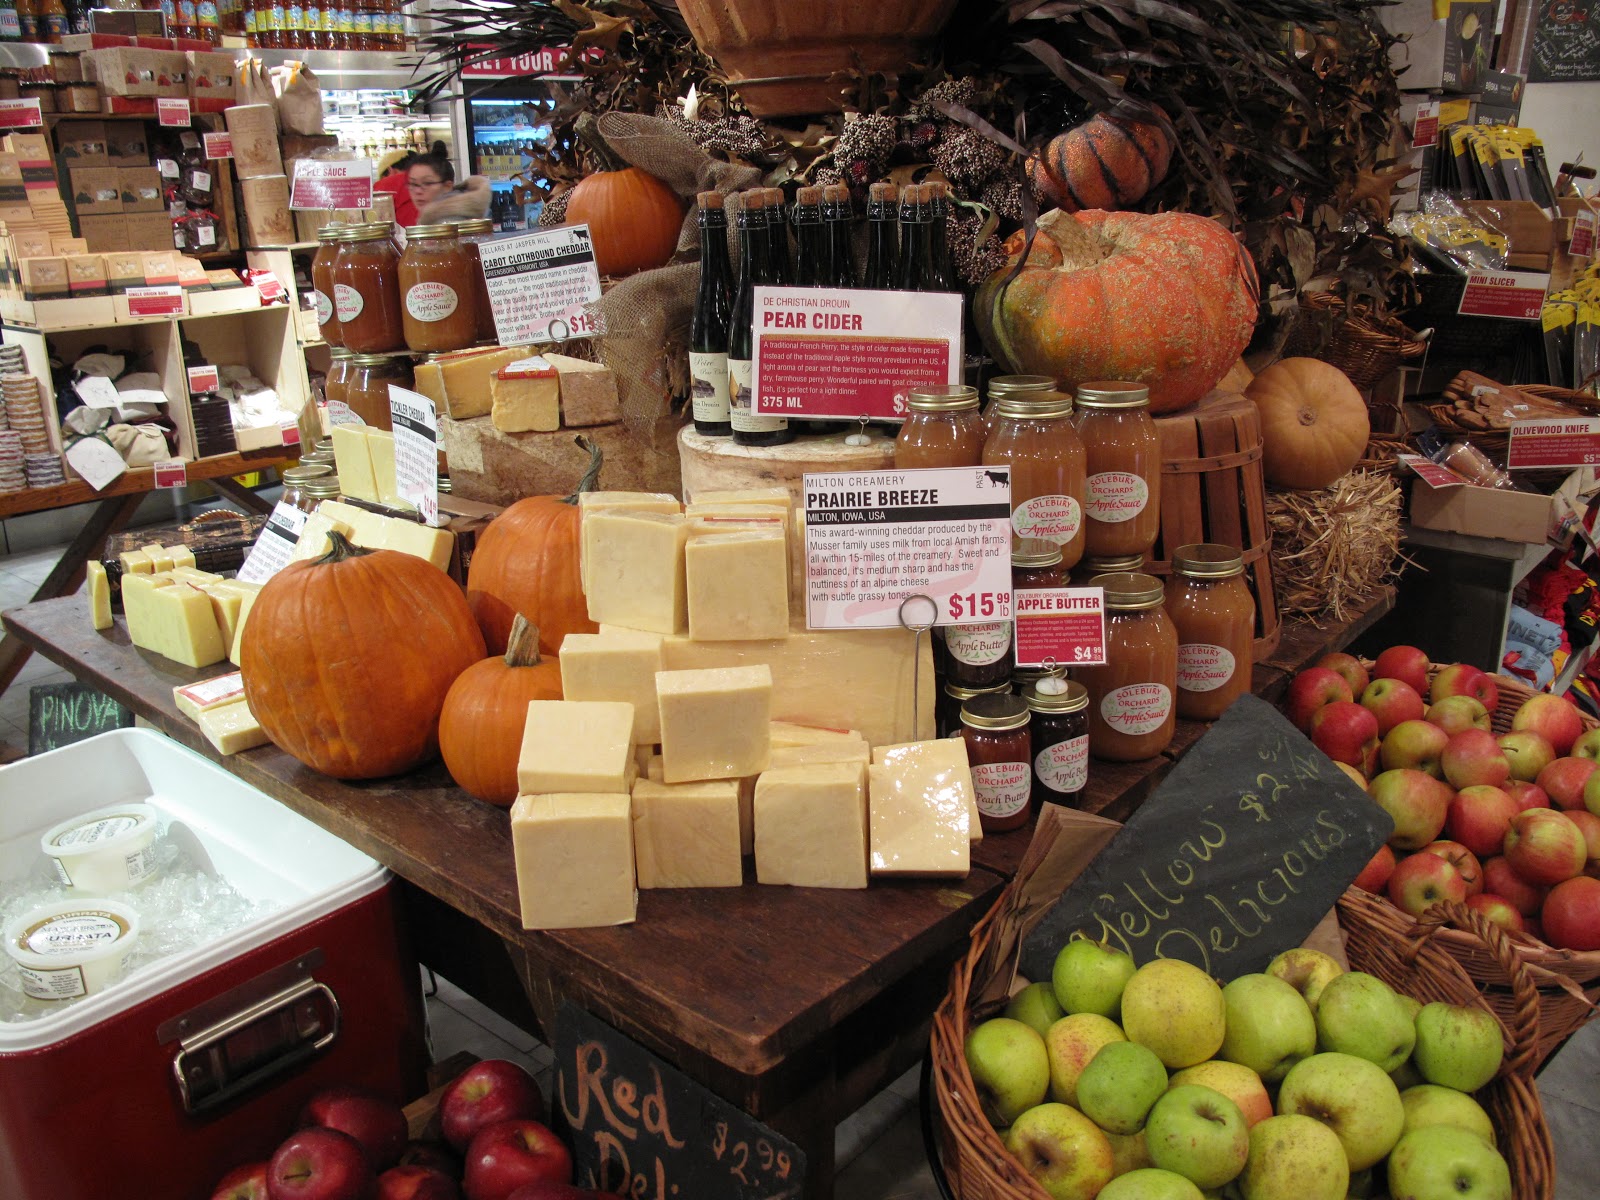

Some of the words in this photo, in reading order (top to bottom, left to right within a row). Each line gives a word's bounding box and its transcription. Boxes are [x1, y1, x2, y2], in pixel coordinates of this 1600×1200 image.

[511, 51, 553, 71] YOUR
[323, 168, 347, 176] SAUCE
[480, 244, 505, 255] CELLARS
[515, 239, 536, 248] JASPER
[484, 257, 506, 268] CABOT
[509, 249, 554, 265] CLOTHBOUND
[557, 242, 590, 255] CHEDDAR
[1470, 276, 1488, 284] MINI
[1489, 277, 1515, 286] SLICER
[412, 284, 445, 294] SOLEBURY
[763, 297, 774, 305] DE
[777, 298, 818, 307] CHRISTIAN
[821, 300, 850, 308] DROUIN
[1525, 308, 1534, 316] $4
[764, 312, 806, 328] PEAR
[813, 314, 863, 331] CIDER
[763, 396, 783, 407] 375
[787, 397, 802, 408] ML
[391, 400, 408, 417] TICKLER
[408, 406, 425, 424] CHEDDAR
[1514, 426, 1562, 435] OLIVEWOOD
[1565, 425, 1589, 433] KNIFE
[1584, 454, 1594, 463] $5
[806, 478, 844, 487] MILTON
[849, 476, 905, 486] CREAMERY
[976, 470, 984, 489] PAST
[1090, 476, 1136, 487] SOLEBURY
[807, 492, 872, 509] PRAIRIE
[878, 489, 939, 506] BREEZE
[1027, 500, 1071, 512] SOLEBURY
[808, 512, 840, 523] MILTON,
[841, 512, 867, 522] IOWA,
[868, 511, 886, 520] USA
[1029, 510, 1070, 519] ORCHARDS
[809, 528, 827, 538] This
[829, 526, 890, 537] award-winning
[892, 524, 925, 535] cheddar
[928, 524, 966, 536] produced
[968, 523, 978, 533] by
[980, 523, 992, 532] the
[809, 541, 840, 551] Musser
[842, 540, 868, 551] family
[870, 540, 890, 548] uses
[892, 539, 910, 548] milk
[911, 538, 931, 547] from
[933, 537, 953, 546] local
[955, 535, 980, 546] Amish
[982, 535, 1007, 545] farms,
[810, 554, 820, 564] all
[821, 553, 847, 563] within
[849, 552, 885, 562] 15-miles
[887, 552, 896, 561] of
[898, 551, 911, 561] the
[913, 551, 953, 562] creamery.
[958, 549, 983, 558] Sweet
[985, 548, 999, 558] and
[811, 566, 850, 578] balanced,
[852, 565, 864, 575] it's
[867, 564, 900, 574] medium
[902, 564, 925, 575] sharp
[927, 563, 943, 572] and
[945, 562, 960, 571] has
[961, 562, 974, 571] the
[811, 579, 848, 589] nuttiness
[850, 578, 859, 588] of
[861, 579, 872, 588] an
[874, 577, 898, 589] alpine
[900, 577, 930, 587] cheese
[811, 592, 830, 602] with
[831, 591, 857, 601] subtle
[859, 592, 886, 603] grassy
[997, 592, 1010, 604] 99
[950, 592, 995, 620] $15
[1017, 599, 1052, 610] APPLE
[1057, 597, 1100, 609] BUTTER
[999, 604, 1009, 617] lb
[955, 623, 1001, 632] ORCHARDS
[950, 639, 979, 653] Apple
[980, 639, 1007, 651] Butter
[1074, 646, 1091, 661] $4
[1117, 688, 1162, 700] SOLEBURY
[1118, 697, 1160, 707] ORCHARDS
[41, 691, 120, 736] PINOVA
[976, 764, 1025, 776] SOLEBURY
[978, 774, 1023, 786] ORCHARDS
[1045, 771, 1076, 784] Apple
[976, 792, 1002, 805] Peach
[1004, 791, 1028, 804] Butter
[1155, 810, 1350, 975] Delicious
[559, 1040, 686, 1149] Red
